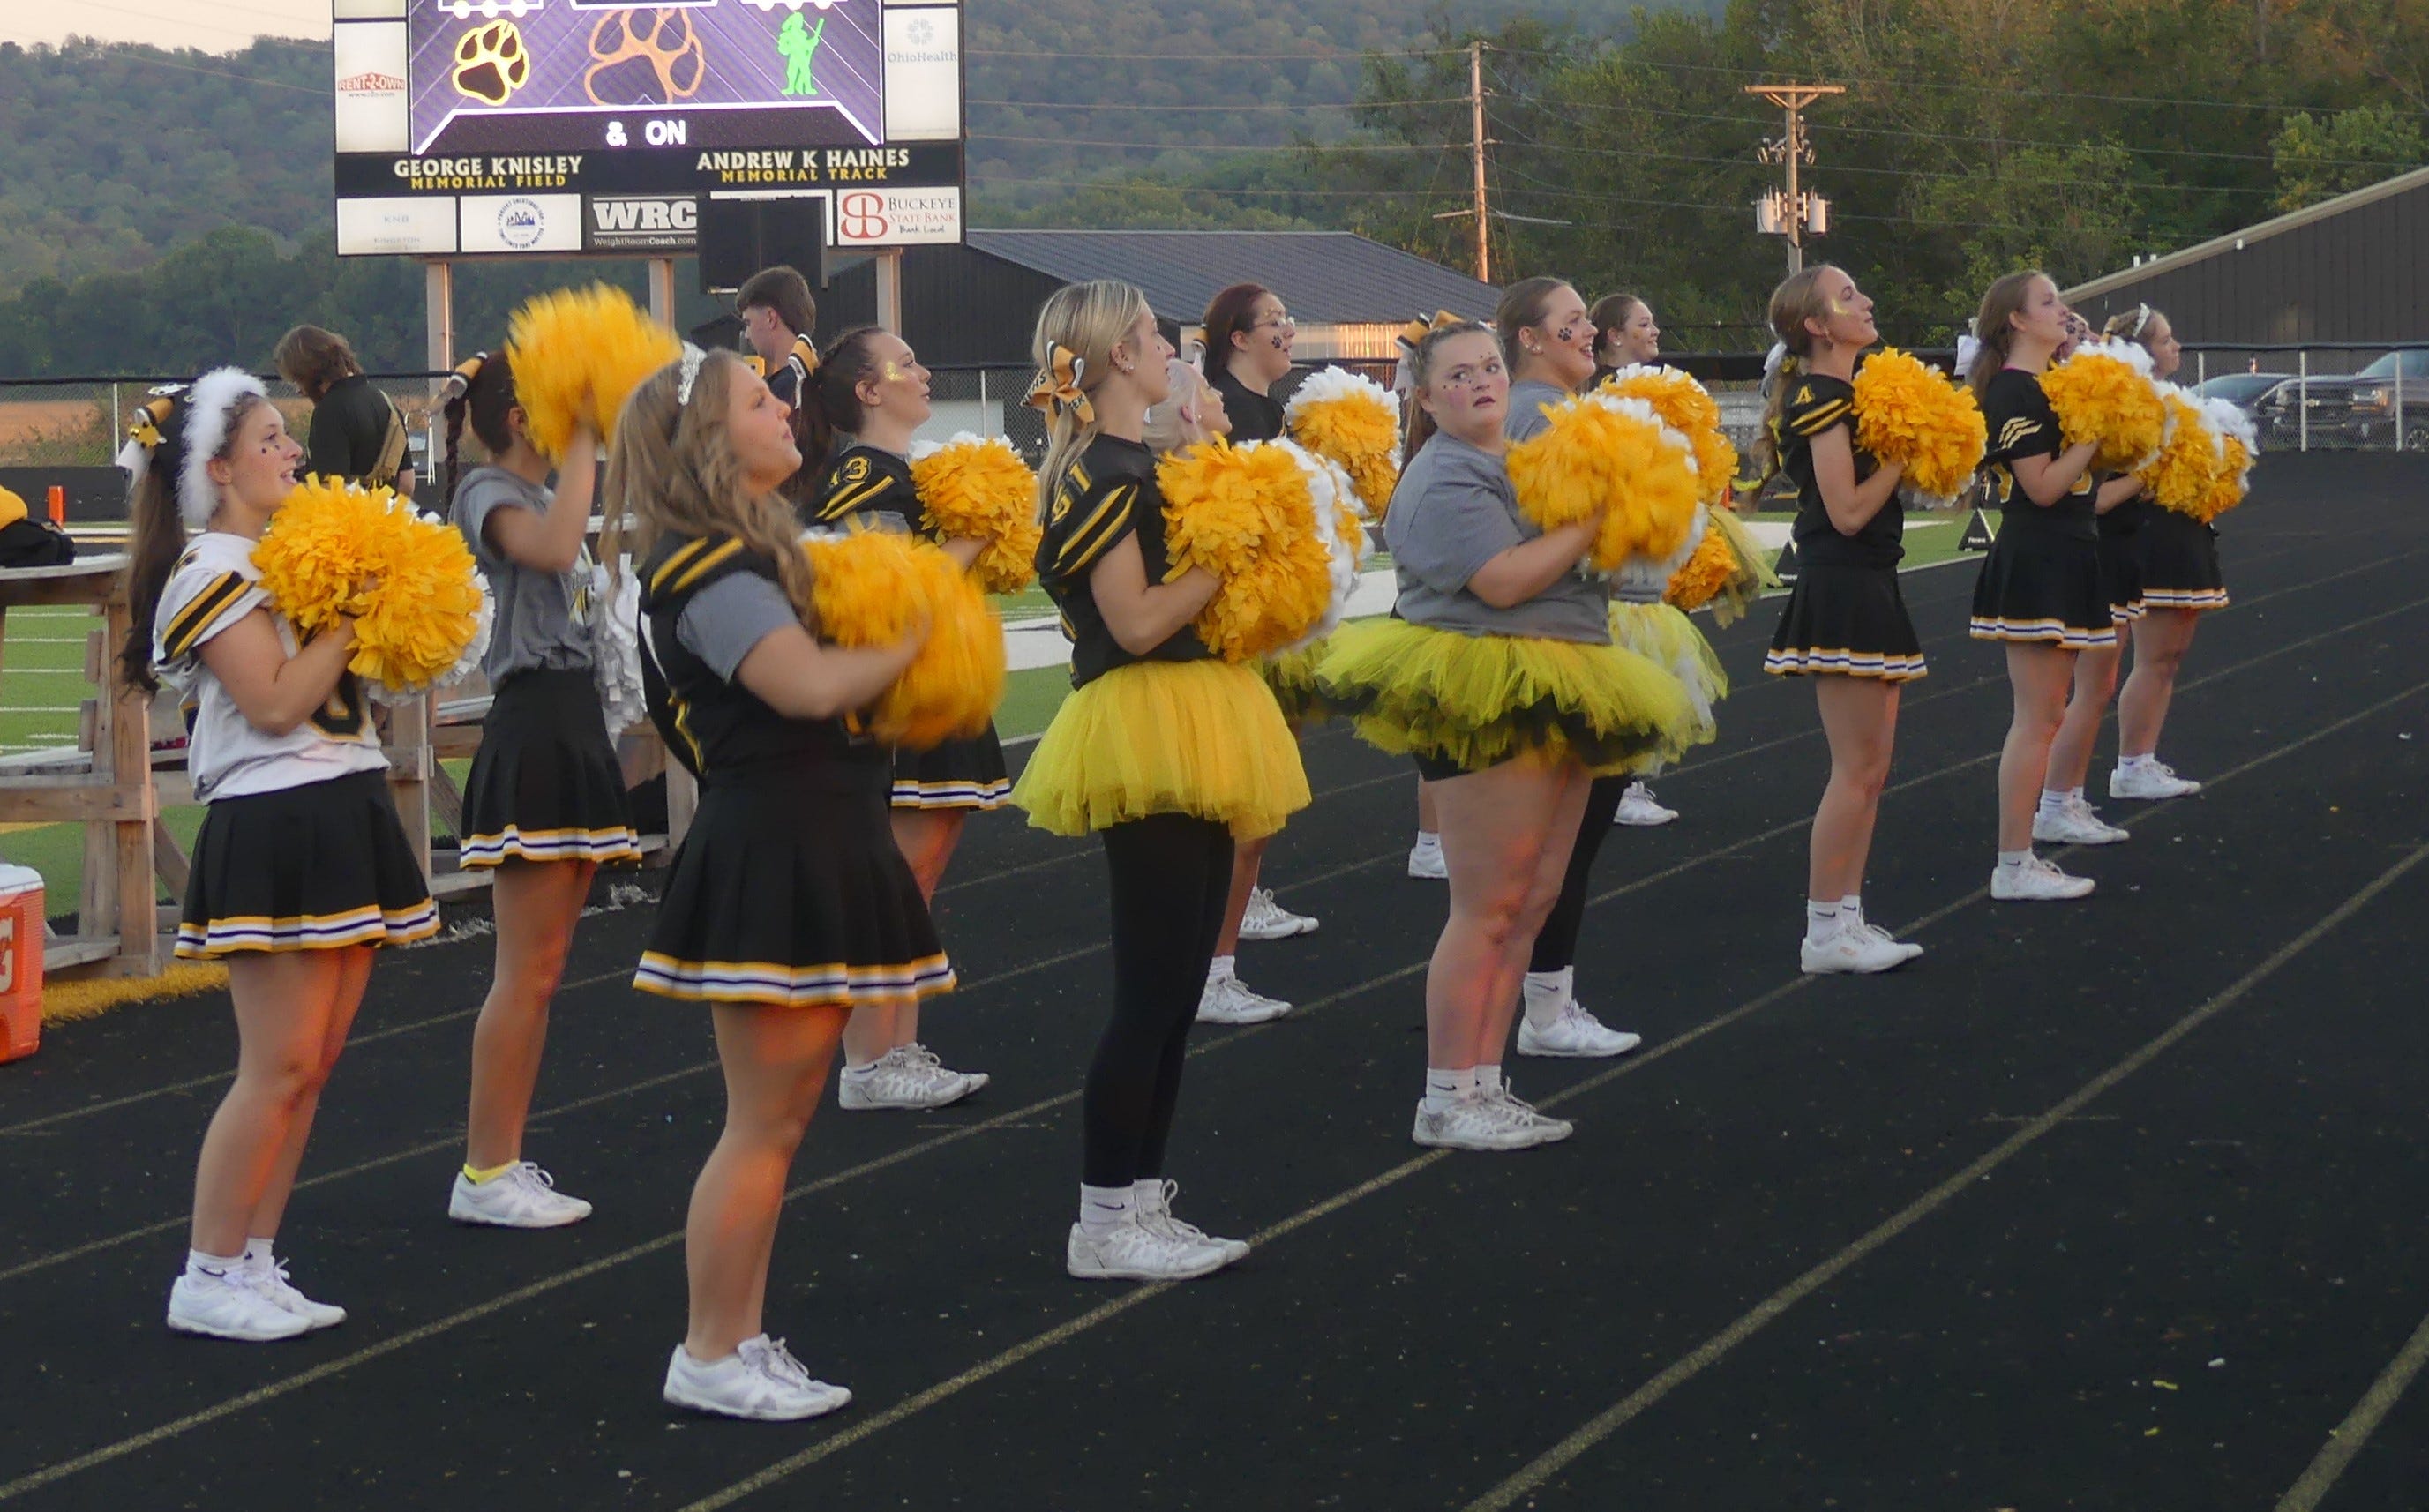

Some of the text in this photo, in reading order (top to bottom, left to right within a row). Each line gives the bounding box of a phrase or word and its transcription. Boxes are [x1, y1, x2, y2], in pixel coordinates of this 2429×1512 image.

[888, 50, 957, 63] OhioHealth
[606, 120, 686, 146] & ON
[394, 155, 582, 177] GEORGE KNISLEY
[696, 148, 909, 171] ANDREW K HAINES
[411, 175, 566, 189] MEMORIAL FIELD
[722, 168, 888, 183] MEMORIAL TRACK
[888, 197, 955, 211] BUCKEYE
[593, 200, 697, 230] WRC
[889, 212, 956, 223] STATE BANK
[594, 236, 697, 247] WeightRoomCoach.com
